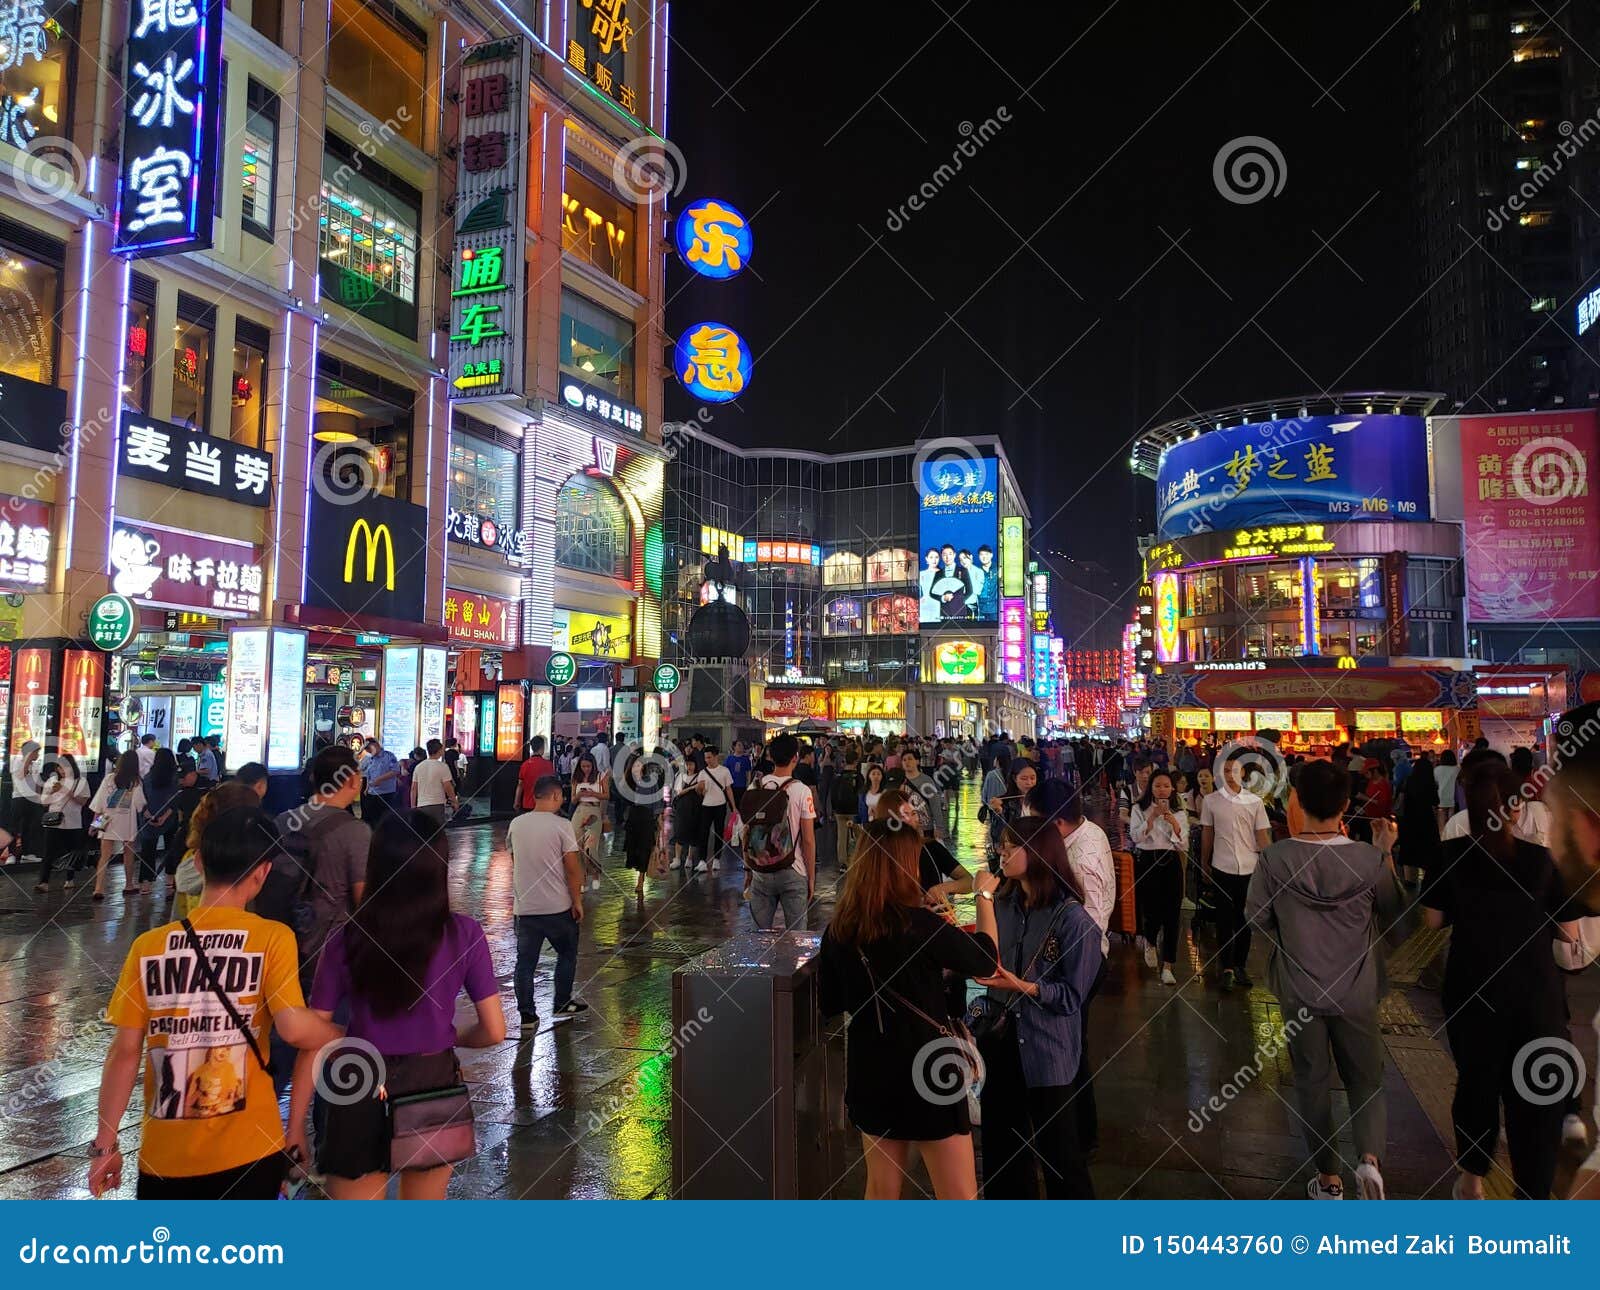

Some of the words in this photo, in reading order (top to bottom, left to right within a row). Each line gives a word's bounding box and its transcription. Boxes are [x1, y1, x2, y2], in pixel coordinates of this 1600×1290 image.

[580, 0, 634, 54] 歌
[568, 40, 636, 114] 量贩式
[126, 424, 269, 495] 麦当劳
[1328, 501, 1350, 513] M3
[1362, 497, 1388, 512] M6
[1397, 501, 1416, 512] M9
